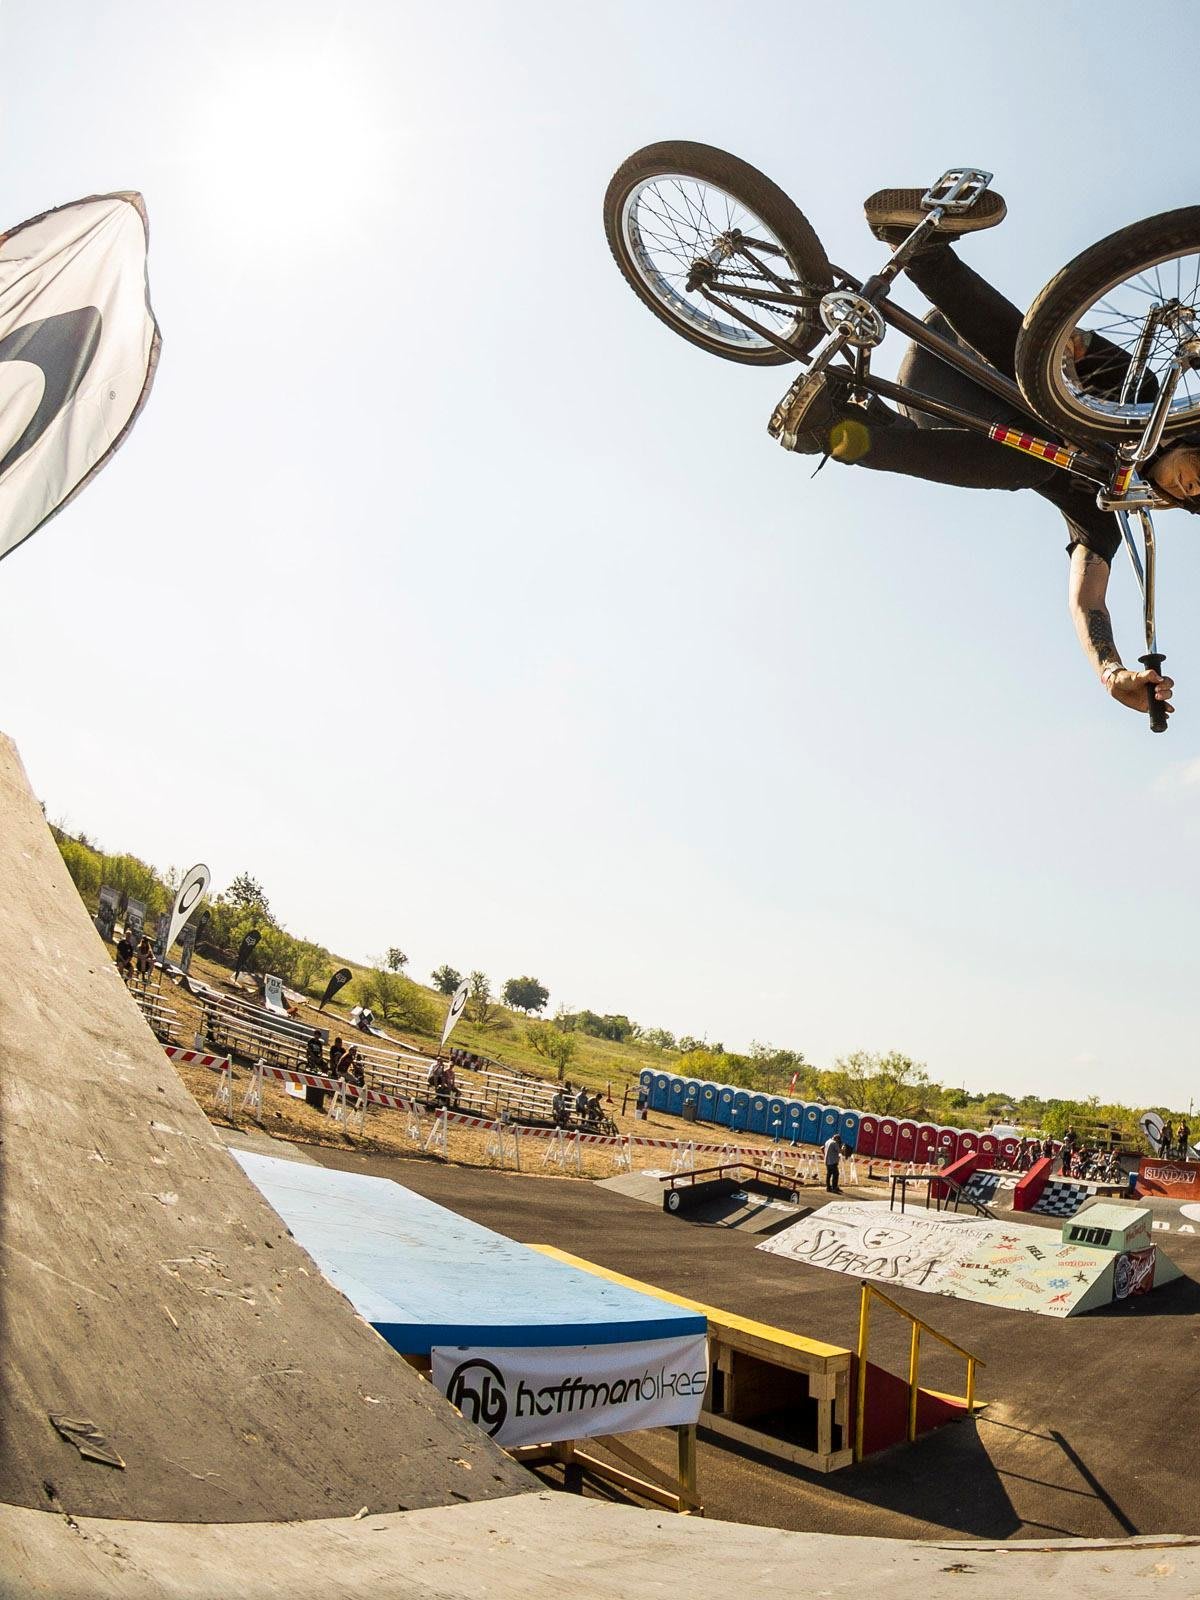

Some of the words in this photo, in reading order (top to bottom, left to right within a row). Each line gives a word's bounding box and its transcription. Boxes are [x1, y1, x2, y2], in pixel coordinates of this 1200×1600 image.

[266, 977, 281, 988] FOX
[967, 1172, 1020, 1190] FIRS
[1146, 1168, 1194, 1184] SUNDAY
[792, 1228, 942, 1286] SUBROSA
[1026, 1244, 1046, 1261] BELL
[515, 1366, 708, 1417] hoffmanbikes
